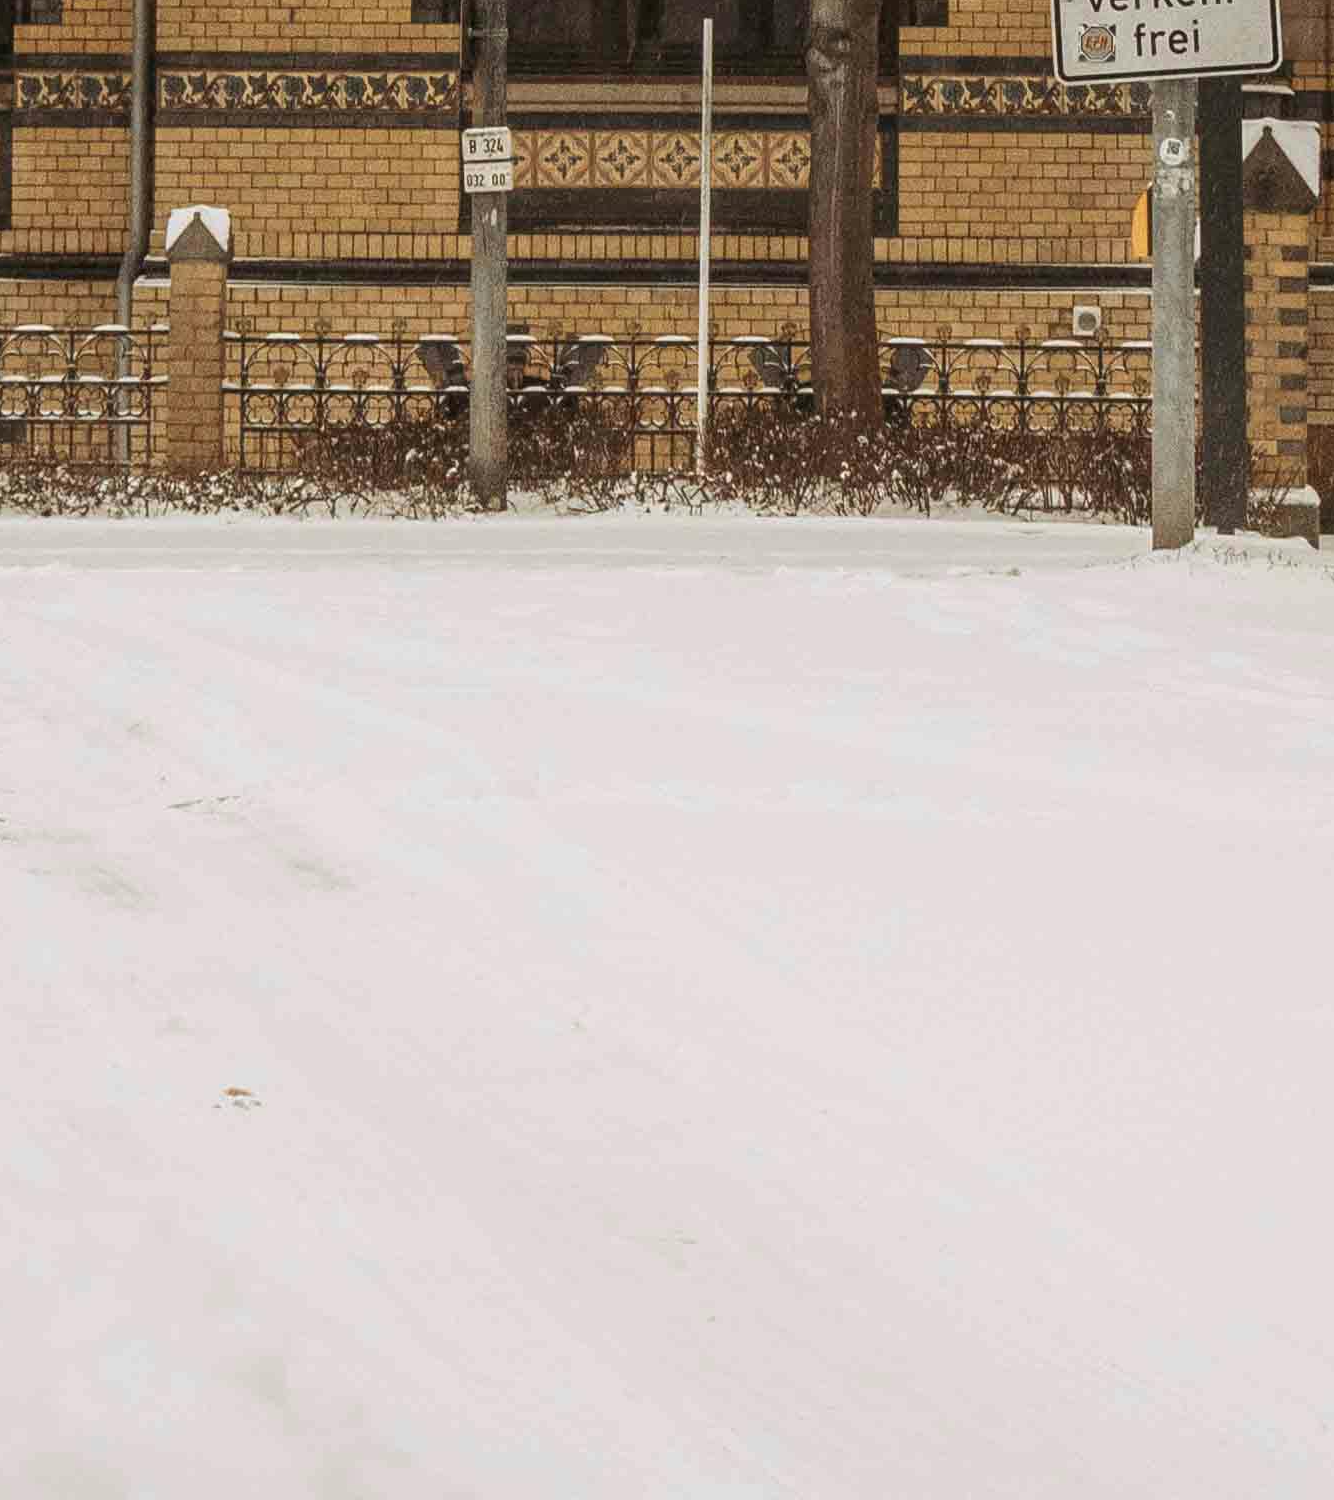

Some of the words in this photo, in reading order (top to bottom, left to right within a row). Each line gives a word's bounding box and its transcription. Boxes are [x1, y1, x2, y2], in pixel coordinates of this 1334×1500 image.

[1133, 19, 1202, 57] frei
[483, 137, 504, 154] 324
[466, 173, 484, 188] 032
